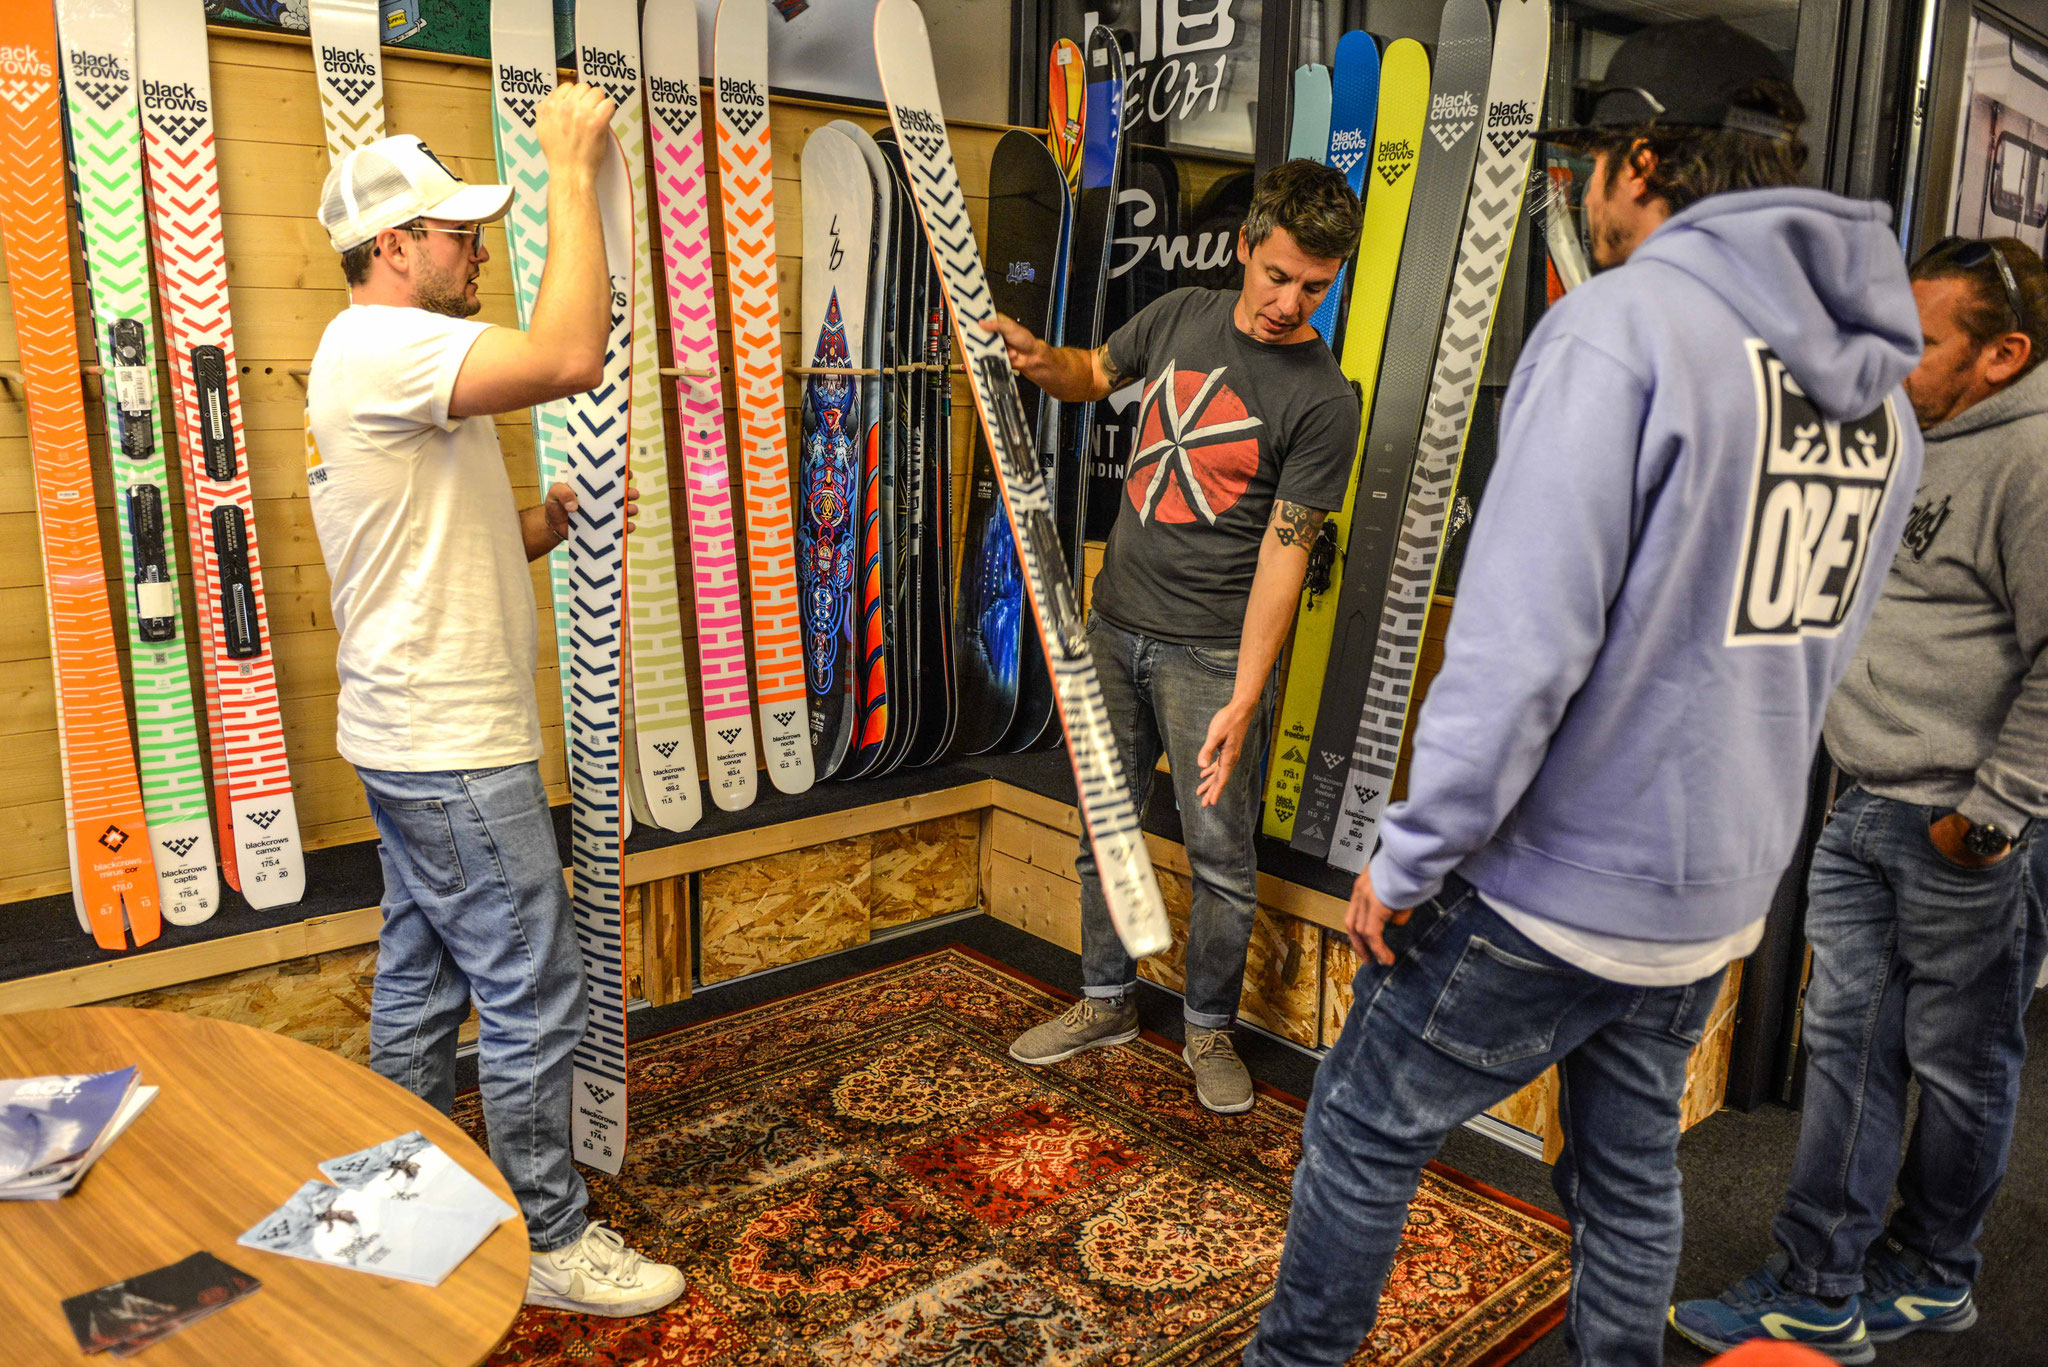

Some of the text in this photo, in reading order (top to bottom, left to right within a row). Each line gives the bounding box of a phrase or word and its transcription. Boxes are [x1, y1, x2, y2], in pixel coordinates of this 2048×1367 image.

[71, 50, 119, 69] black
[322, 46, 365, 64] black
[582, 45, 627, 67] black
[73, 65, 130, 82] crows
[323, 60, 376, 77] crows
[499, 64, 543, 84] black
[583, 62, 637, 81] crows
[142, 79, 195, 99] black
[500, 80, 553, 97] crows
[650, 76, 689, 94] black
[720, 76, 756, 95] black
[144, 95, 208, 113] crows
[651, 90, 698, 107] crows
[721, 90, 765, 107] crows
[1432, 91, 1473, 109] black
[895, 105, 934, 123] black
[1430, 104, 1479, 121] crows
[1489, 99, 1528, 117] black
[899, 119, 945, 135] crows
[1487, 113, 1534, 128] crows
[1332, 128, 1362, 142] black
[1331, 138, 1367, 152] crows
[1379, 139, 1410, 155] black
[1377, 147, 1414, 162] crows
[1107, 188, 1233, 279] Gnu
[1747, 479, 1883, 630] OBEY
[1284, 729, 1310, 742] freebird
[1292, 723, 1304, 733] orb
[772, 733, 801, 743] blackcrows
[717, 751, 747, 761] blackcrows
[724, 757, 741, 766] corvus
[653, 766, 686, 776] blackcrows
[661, 773, 680, 781] anima
[1283, 769, 1299, 780] 173.1
[665, 784, 680, 792] 189.2
[722, 778, 746, 789] 10.7 21
[1276, 781, 1301, 794] 9.0 18
[1312, 773, 1343, 788] blackcrows
[661, 794, 687, 805] 11.5 19
[1275, 801, 1296, 812] crows
[1276, 794, 1293, 806] black
[1344, 809, 1375, 824] blackcrows
[245, 837, 289, 850] blackcrows
[255, 845, 281, 855] camox
[1355, 843, 1364, 852] 25
[94, 856, 142, 872] blackcrows
[261, 859, 280, 868] 175.4
[99, 865, 138, 879] minus cor
[161, 864, 207, 879] blackcrows
[174, 874, 198, 884] captis
[255, 870, 288, 883] 9.7 20
[178, 889, 199, 899] 178.4
[140, 899, 151, 908] 13
[174, 901, 208, 914] 9.0 18
[580, 1106, 618, 1127] blackcrows
[589, 1118, 609, 1130] serpo
[590, 1131, 607, 1142] 174.1
[583, 1140, 612, 1157] 9.3 20
